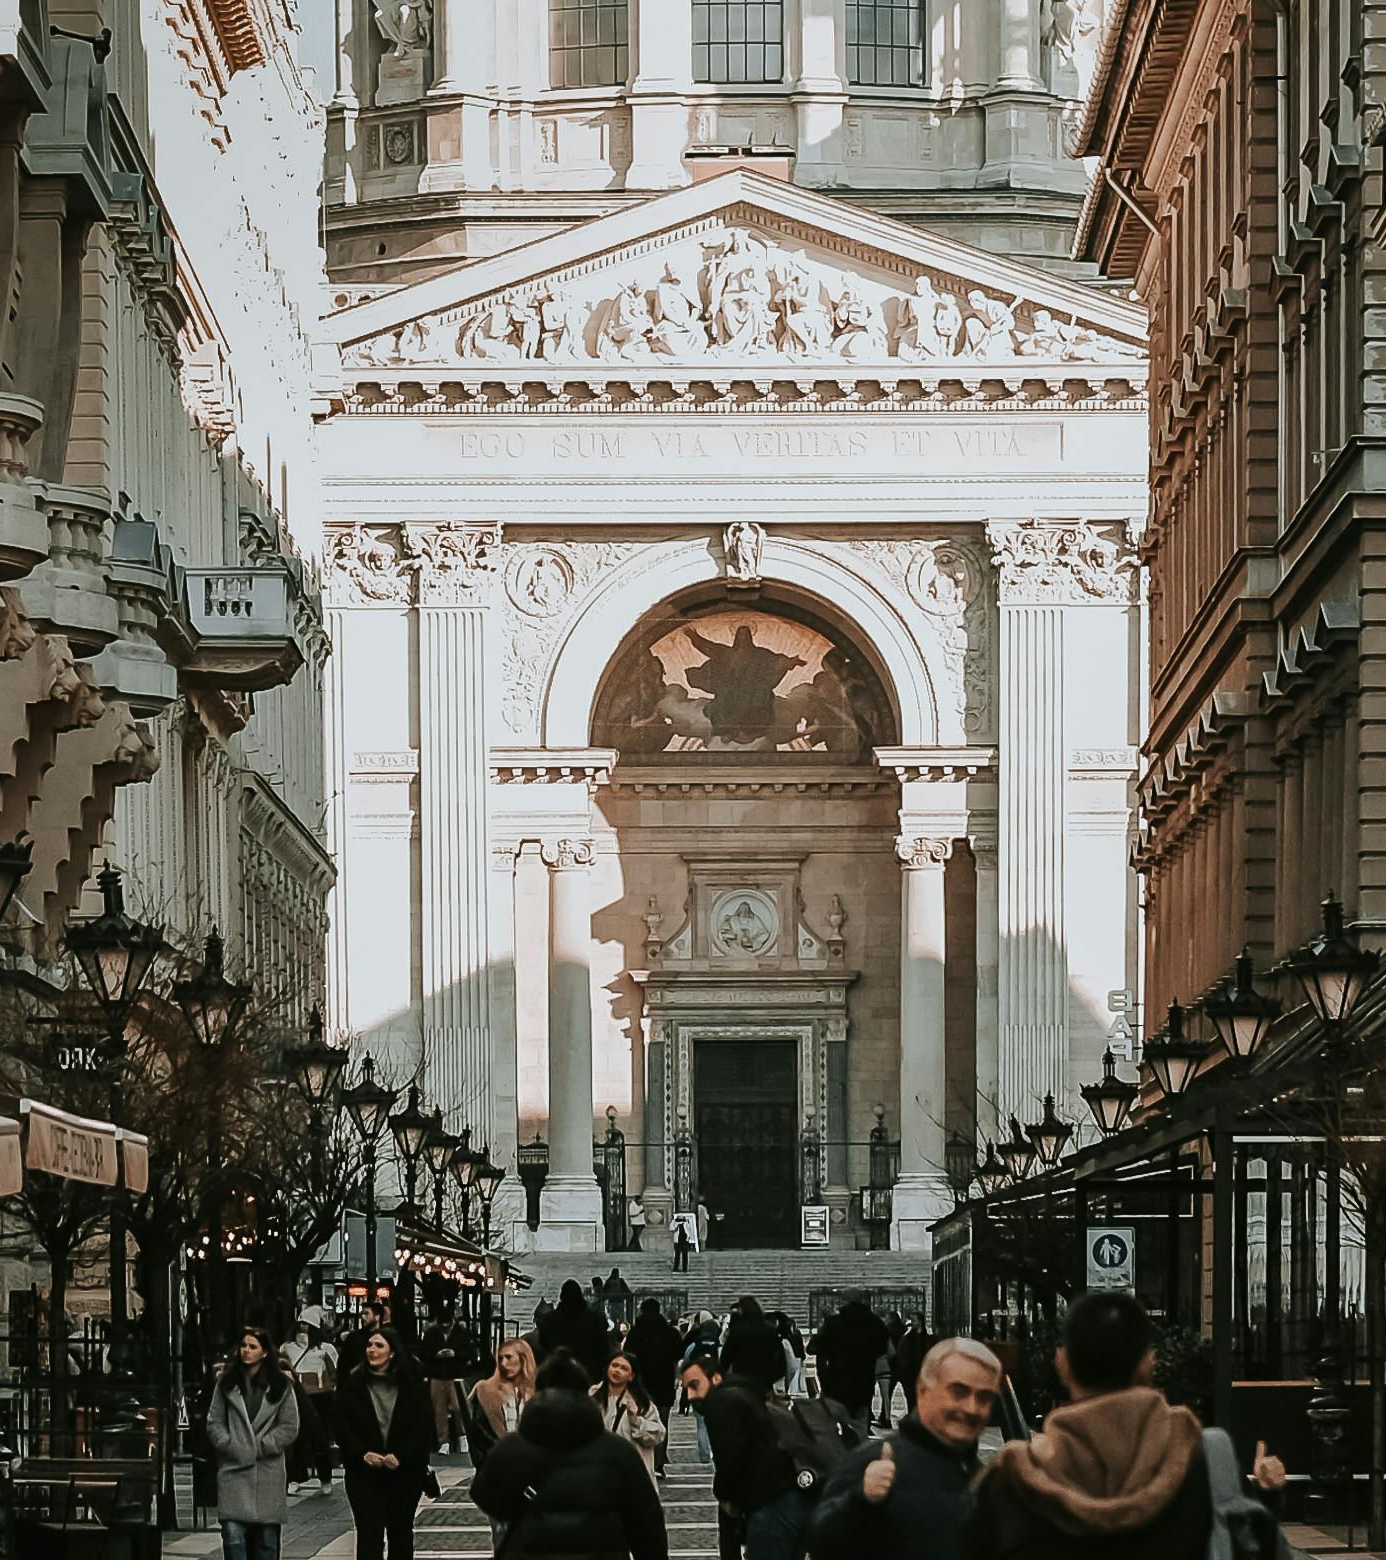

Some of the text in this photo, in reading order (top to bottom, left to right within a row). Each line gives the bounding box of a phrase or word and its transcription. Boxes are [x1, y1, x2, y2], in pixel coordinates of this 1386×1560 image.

[459, 430, 1028, 459] EGO SUM VIA VERITAS ET VITA
